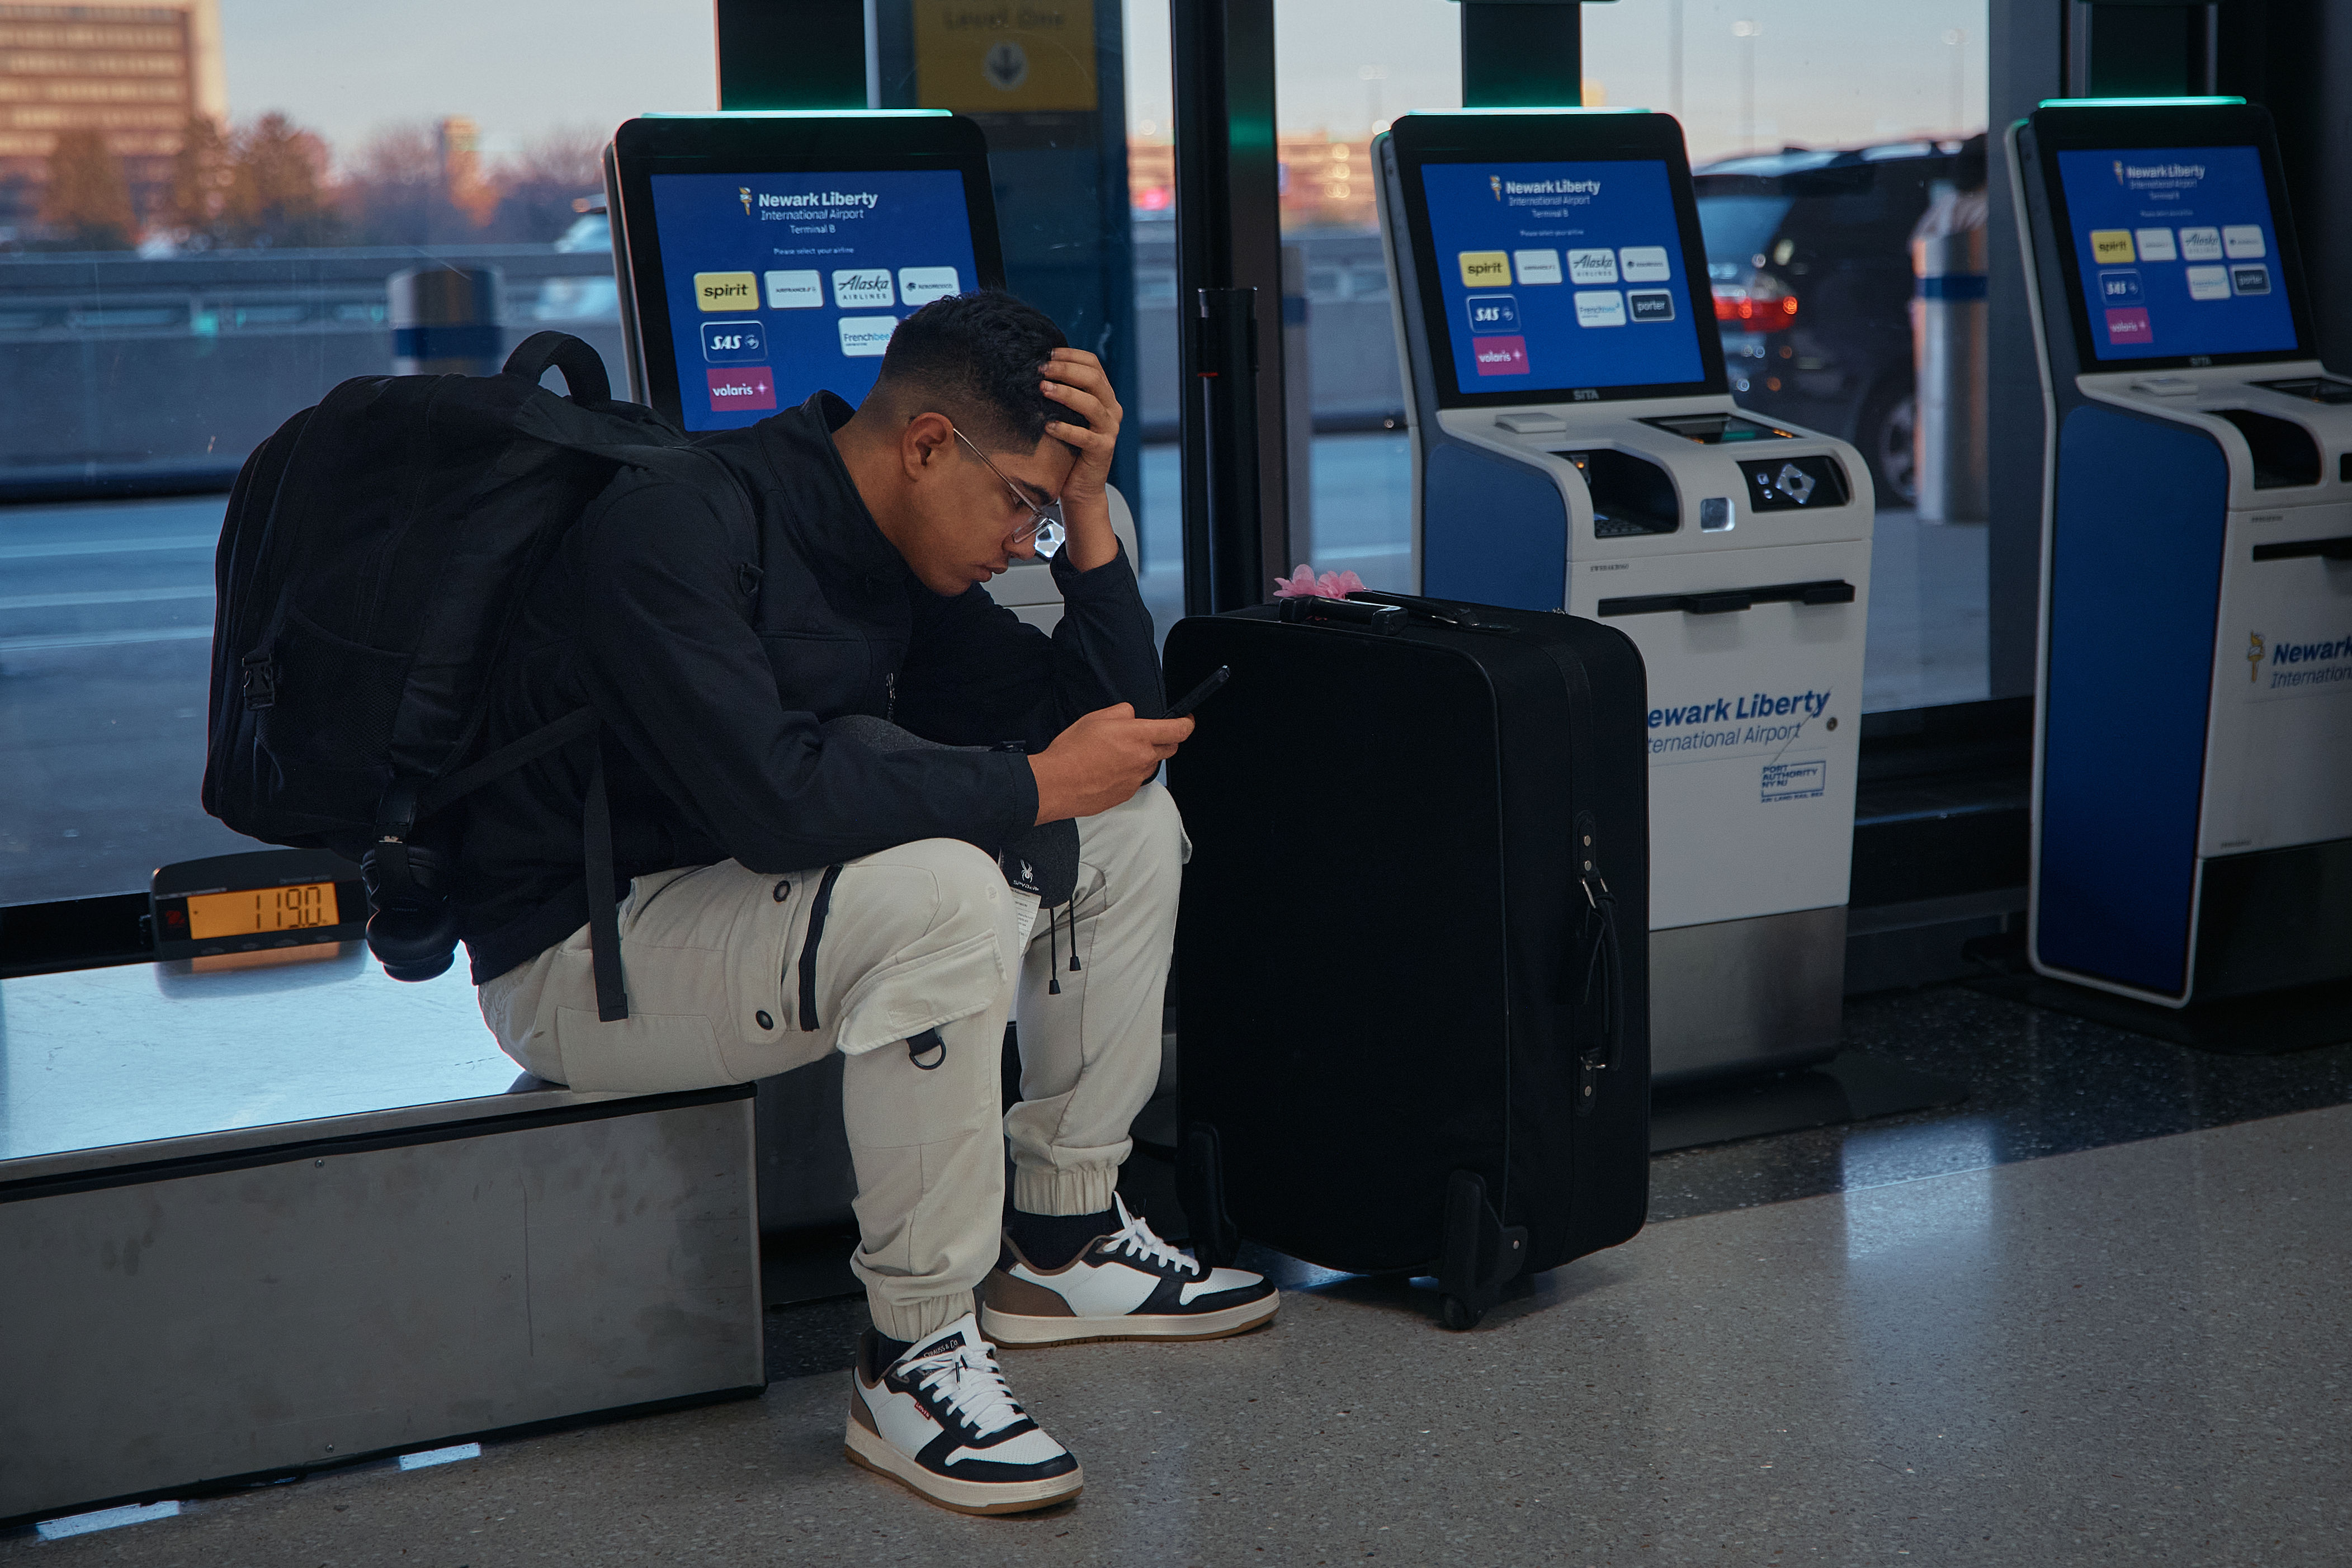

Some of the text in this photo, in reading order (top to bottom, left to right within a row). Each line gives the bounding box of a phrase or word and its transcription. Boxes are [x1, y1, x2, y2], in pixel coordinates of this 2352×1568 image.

[2127, 164, 2205, 180] Newark Liberty
[1506, 179, 1600, 196] Newark Liberty
[758, 191, 878, 209] Newark Liberty
[1509, 195, 1590, 206] International Airport
[761, 209, 863, 221] International Airport
[790, 224, 837, 234] Terminal B
[1574, 254, 1613, 269] Alaska
[1468, 263, 1503, 277] spirit
[839, 275, 890, 292] Alaska
[704, 284, 749, 299] spirit
[1637, 301, 1665, 313] porter
[1475, 307, 1500, 322] SAS
[710, 335, 742, 350] SAS
[1478, 350, 1512, 363] volaris
[712, 383, 753, 396] volaris
[1574, 389, 1599, 400] SITA
[2270, 666, 2352, 688] Internation
[1648, 690, 1831, 729] ewark Liberty
[1648, 722, 1801, 754] ternational Airport
[1763, 765, 1788, 773] PORT
[1763, 768, 1818, 781] AUTHORITY
[923, 1345, 945, 1358] STRAUSS
